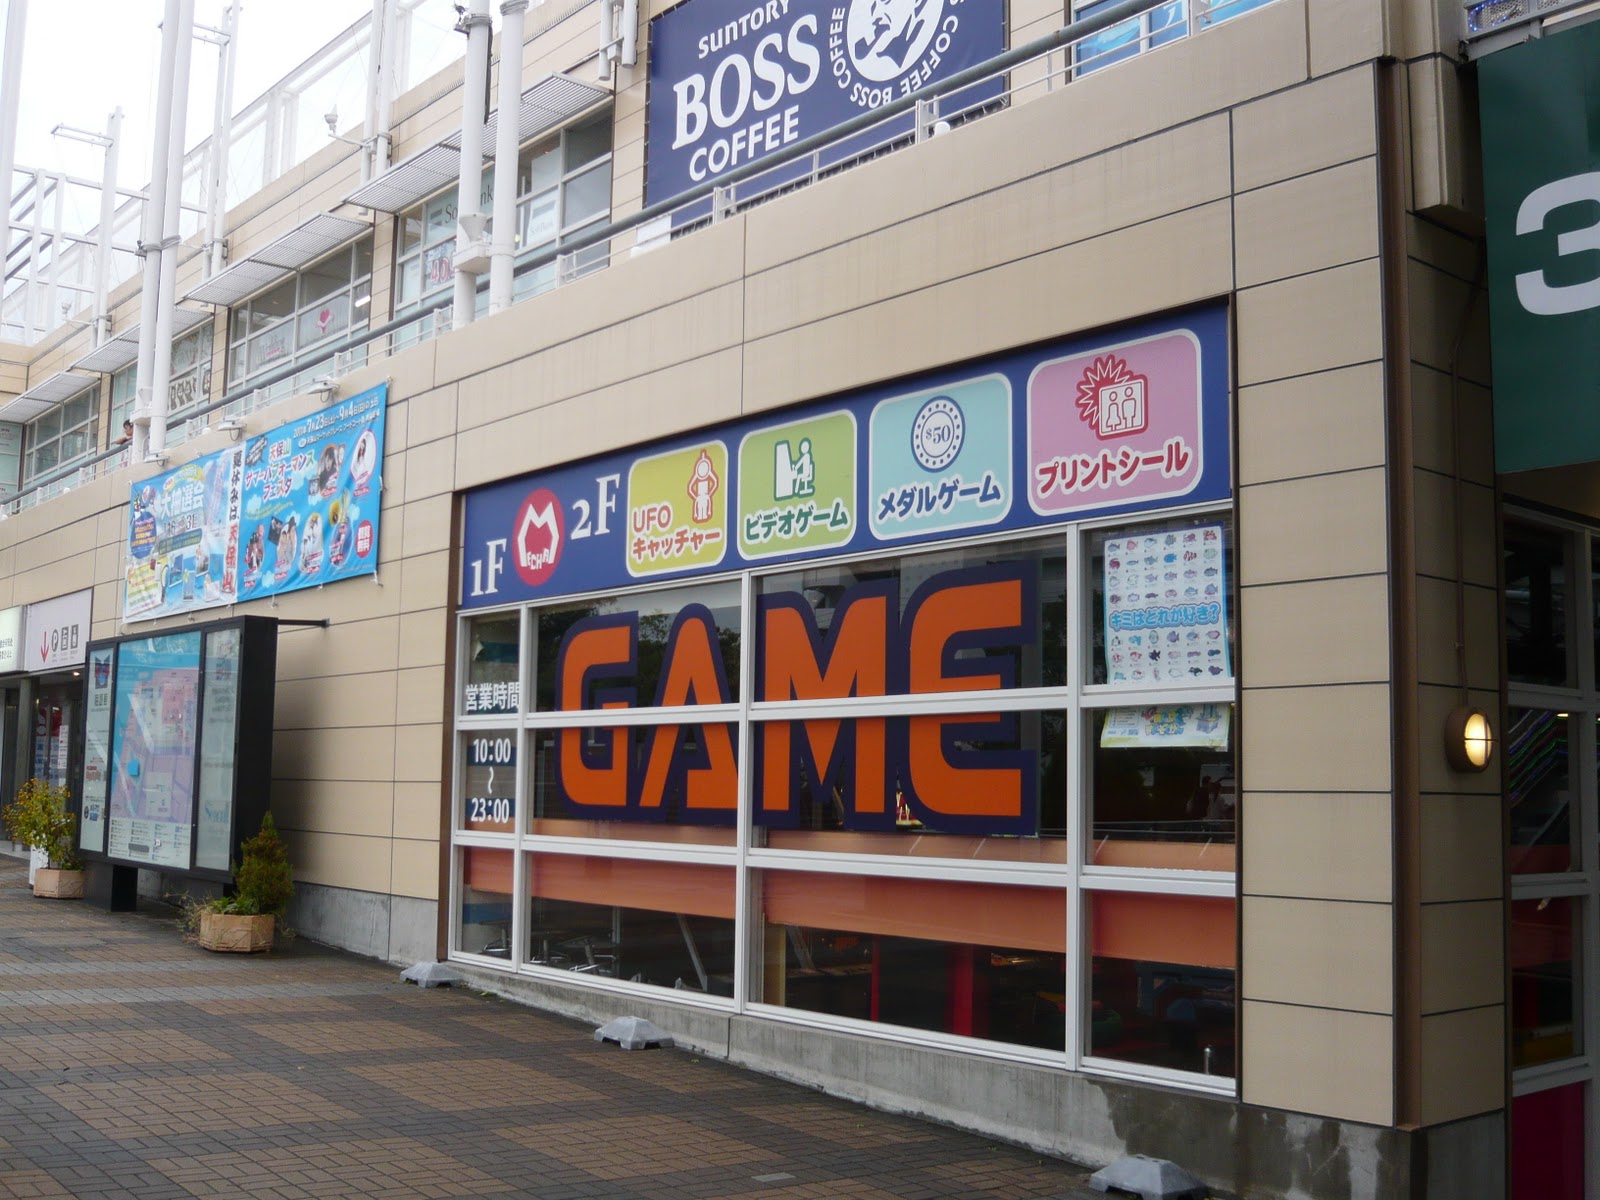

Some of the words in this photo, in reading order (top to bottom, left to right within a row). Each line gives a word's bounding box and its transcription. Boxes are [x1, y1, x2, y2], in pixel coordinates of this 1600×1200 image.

[829, 7, 852, 89] COFFEE
[900, 15, 959, 98] COFFEE
[671, 14, 821, 150] BOSS
[850, 82, 893, 109] BOSS
[689, 105, 800, 181] COFFEE
[925, 424, 952, 445] $50
[1037, 441, 1189, 495] プリントシール
[571, 474, 621, 540] 2F
[633, 505, 671, 533] UFO
[877, 475, 1001, 520] メダルゲーム
[745, 502, 848, 541] ビデオゲーム
[633, 529, 720, 560] キャッチャー
[470, 538, 507, 597] 1F
[465, 681, 520, 711] 営業時間
[560, 578, 1022, 818] GAME
[473, 738, 511, 763] 10:00
[470, 797, 510, 824] 23:00
